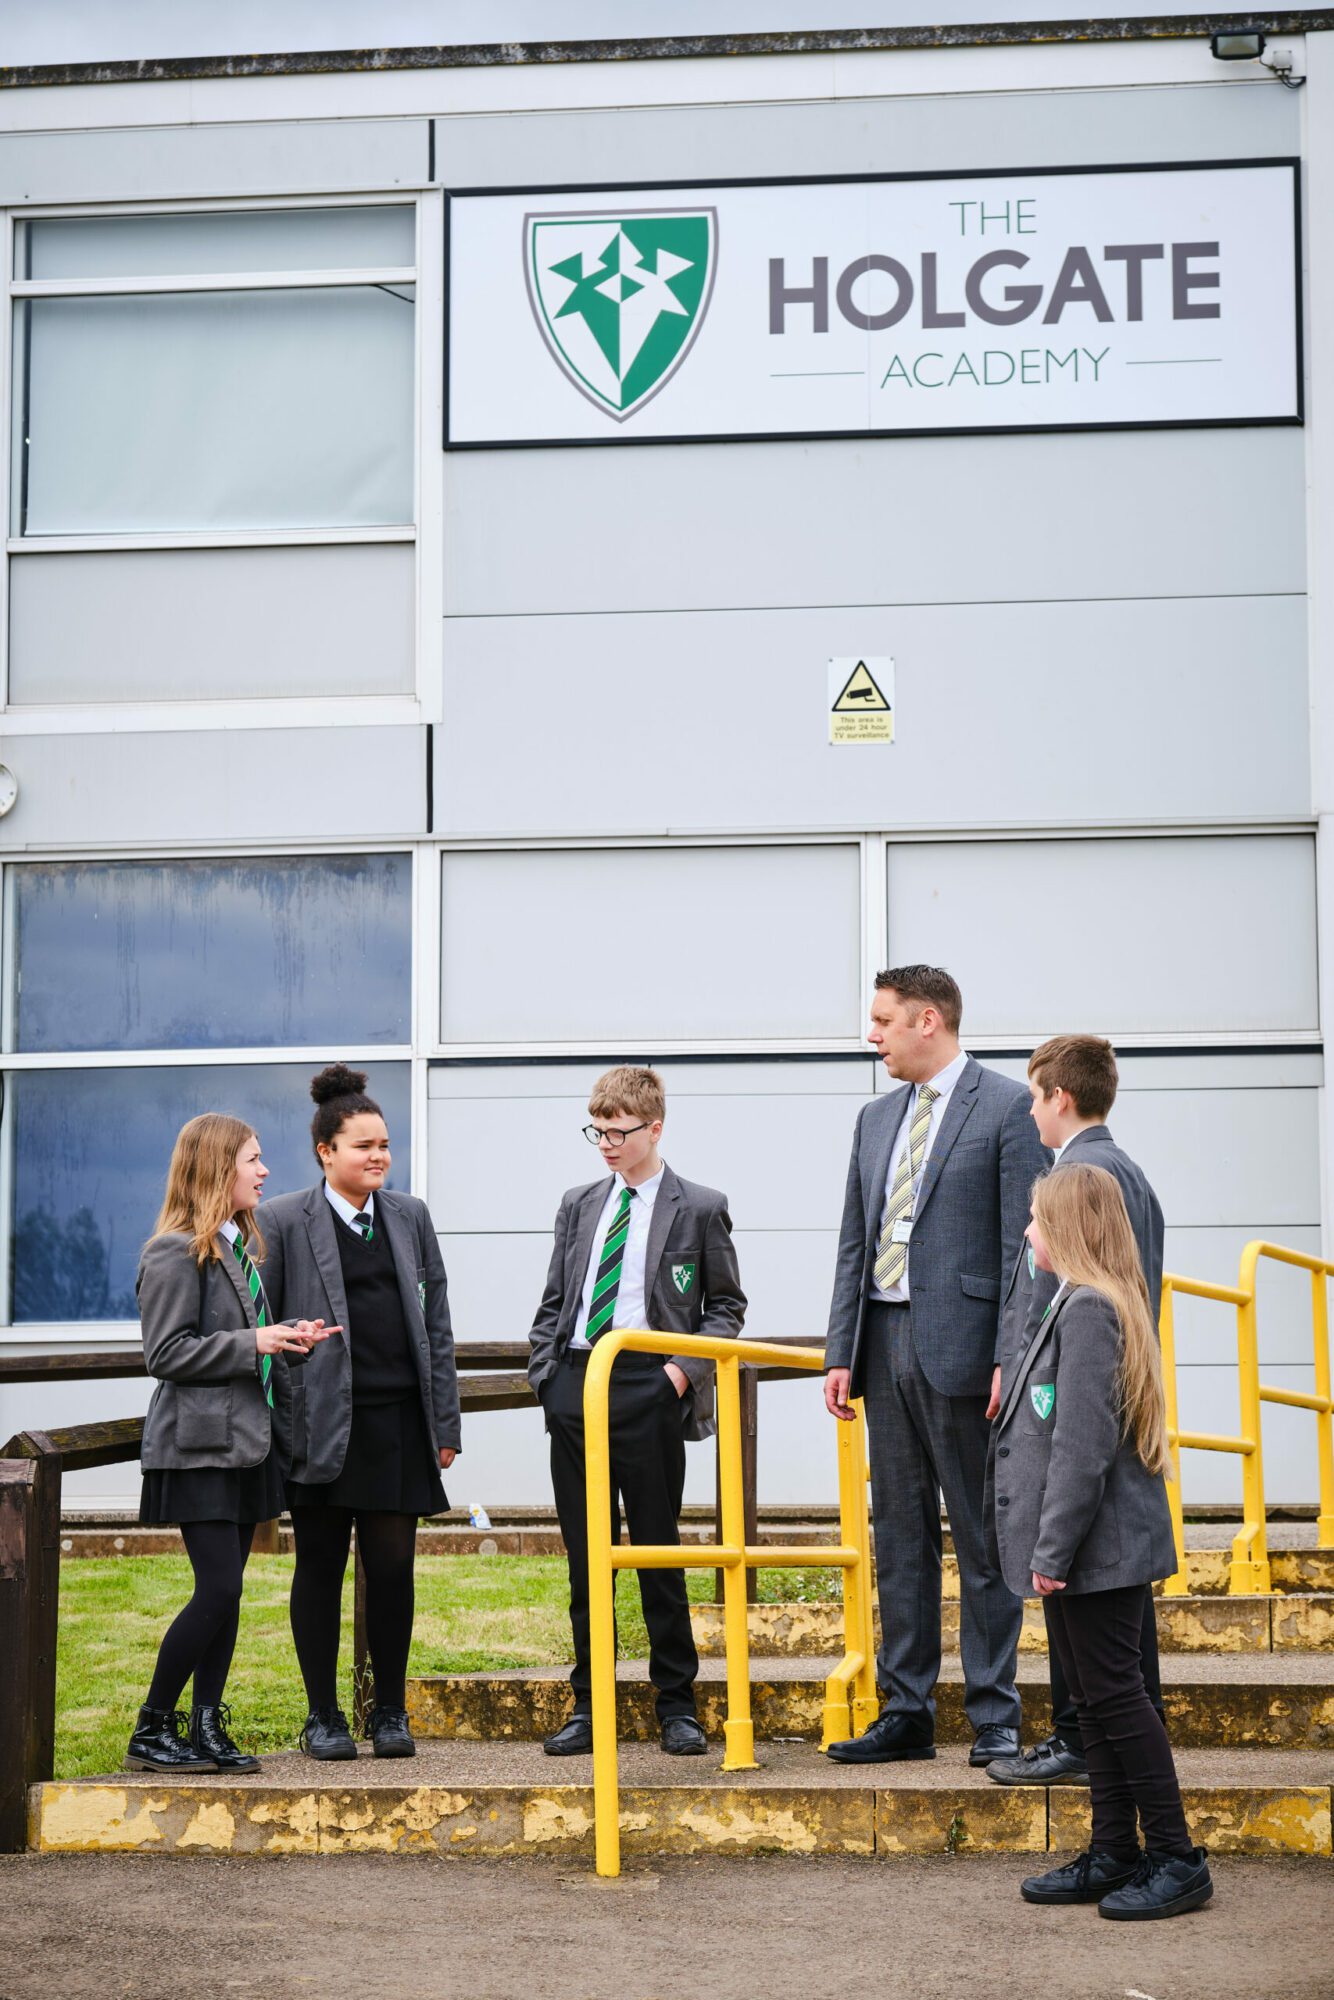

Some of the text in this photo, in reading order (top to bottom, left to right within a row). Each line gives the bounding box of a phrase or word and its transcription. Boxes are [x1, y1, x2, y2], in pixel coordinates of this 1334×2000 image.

[949, 199, 1037, 236] THE
[769, 241, 1221, 335] HOLGATE
[881, 347, 1110, 389] ACADEMY
